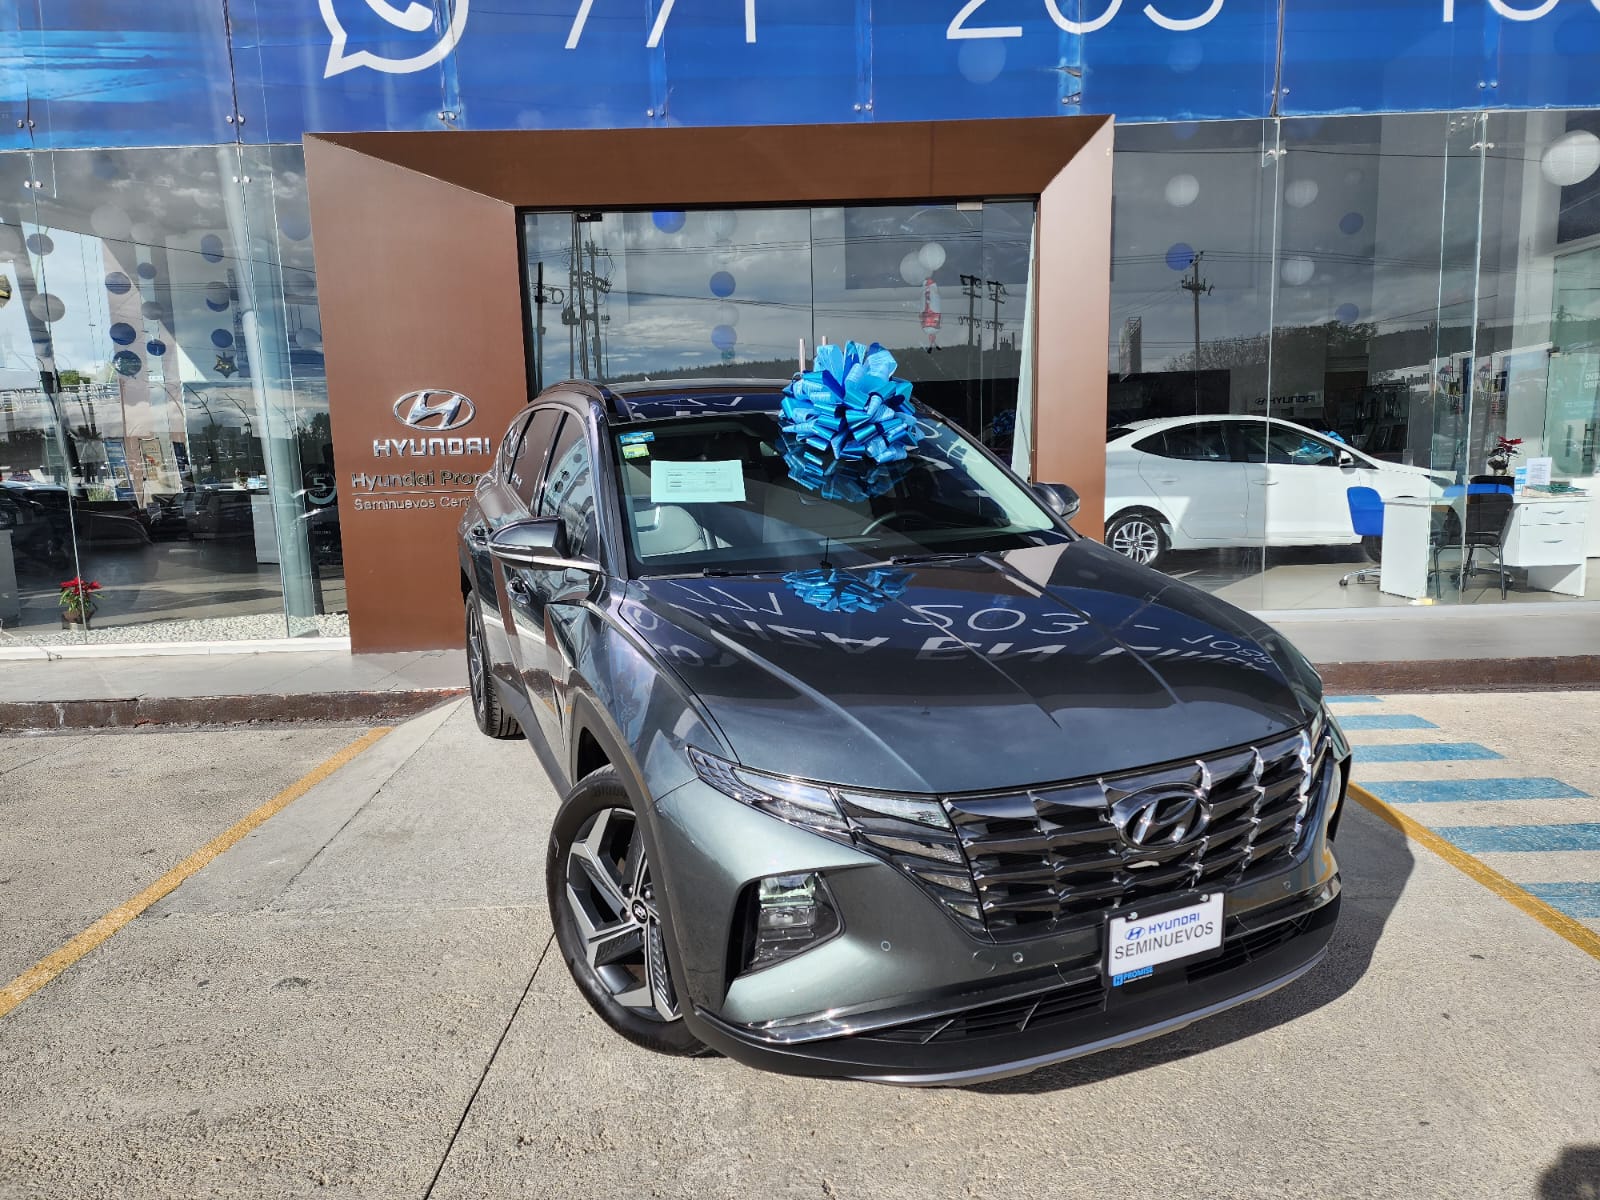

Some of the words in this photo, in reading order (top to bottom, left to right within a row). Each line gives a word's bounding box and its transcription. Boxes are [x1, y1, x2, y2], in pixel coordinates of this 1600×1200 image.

[373, 437, 490, 457] HYUNDAI
[351, 470, 434, 490] Hyundai
[354, 498, 436, 511] Seminuevos
[1148, 913, 1200, 934] HYUNDAI
[1114, 921, 1214, 960] SEMINUEVOS
